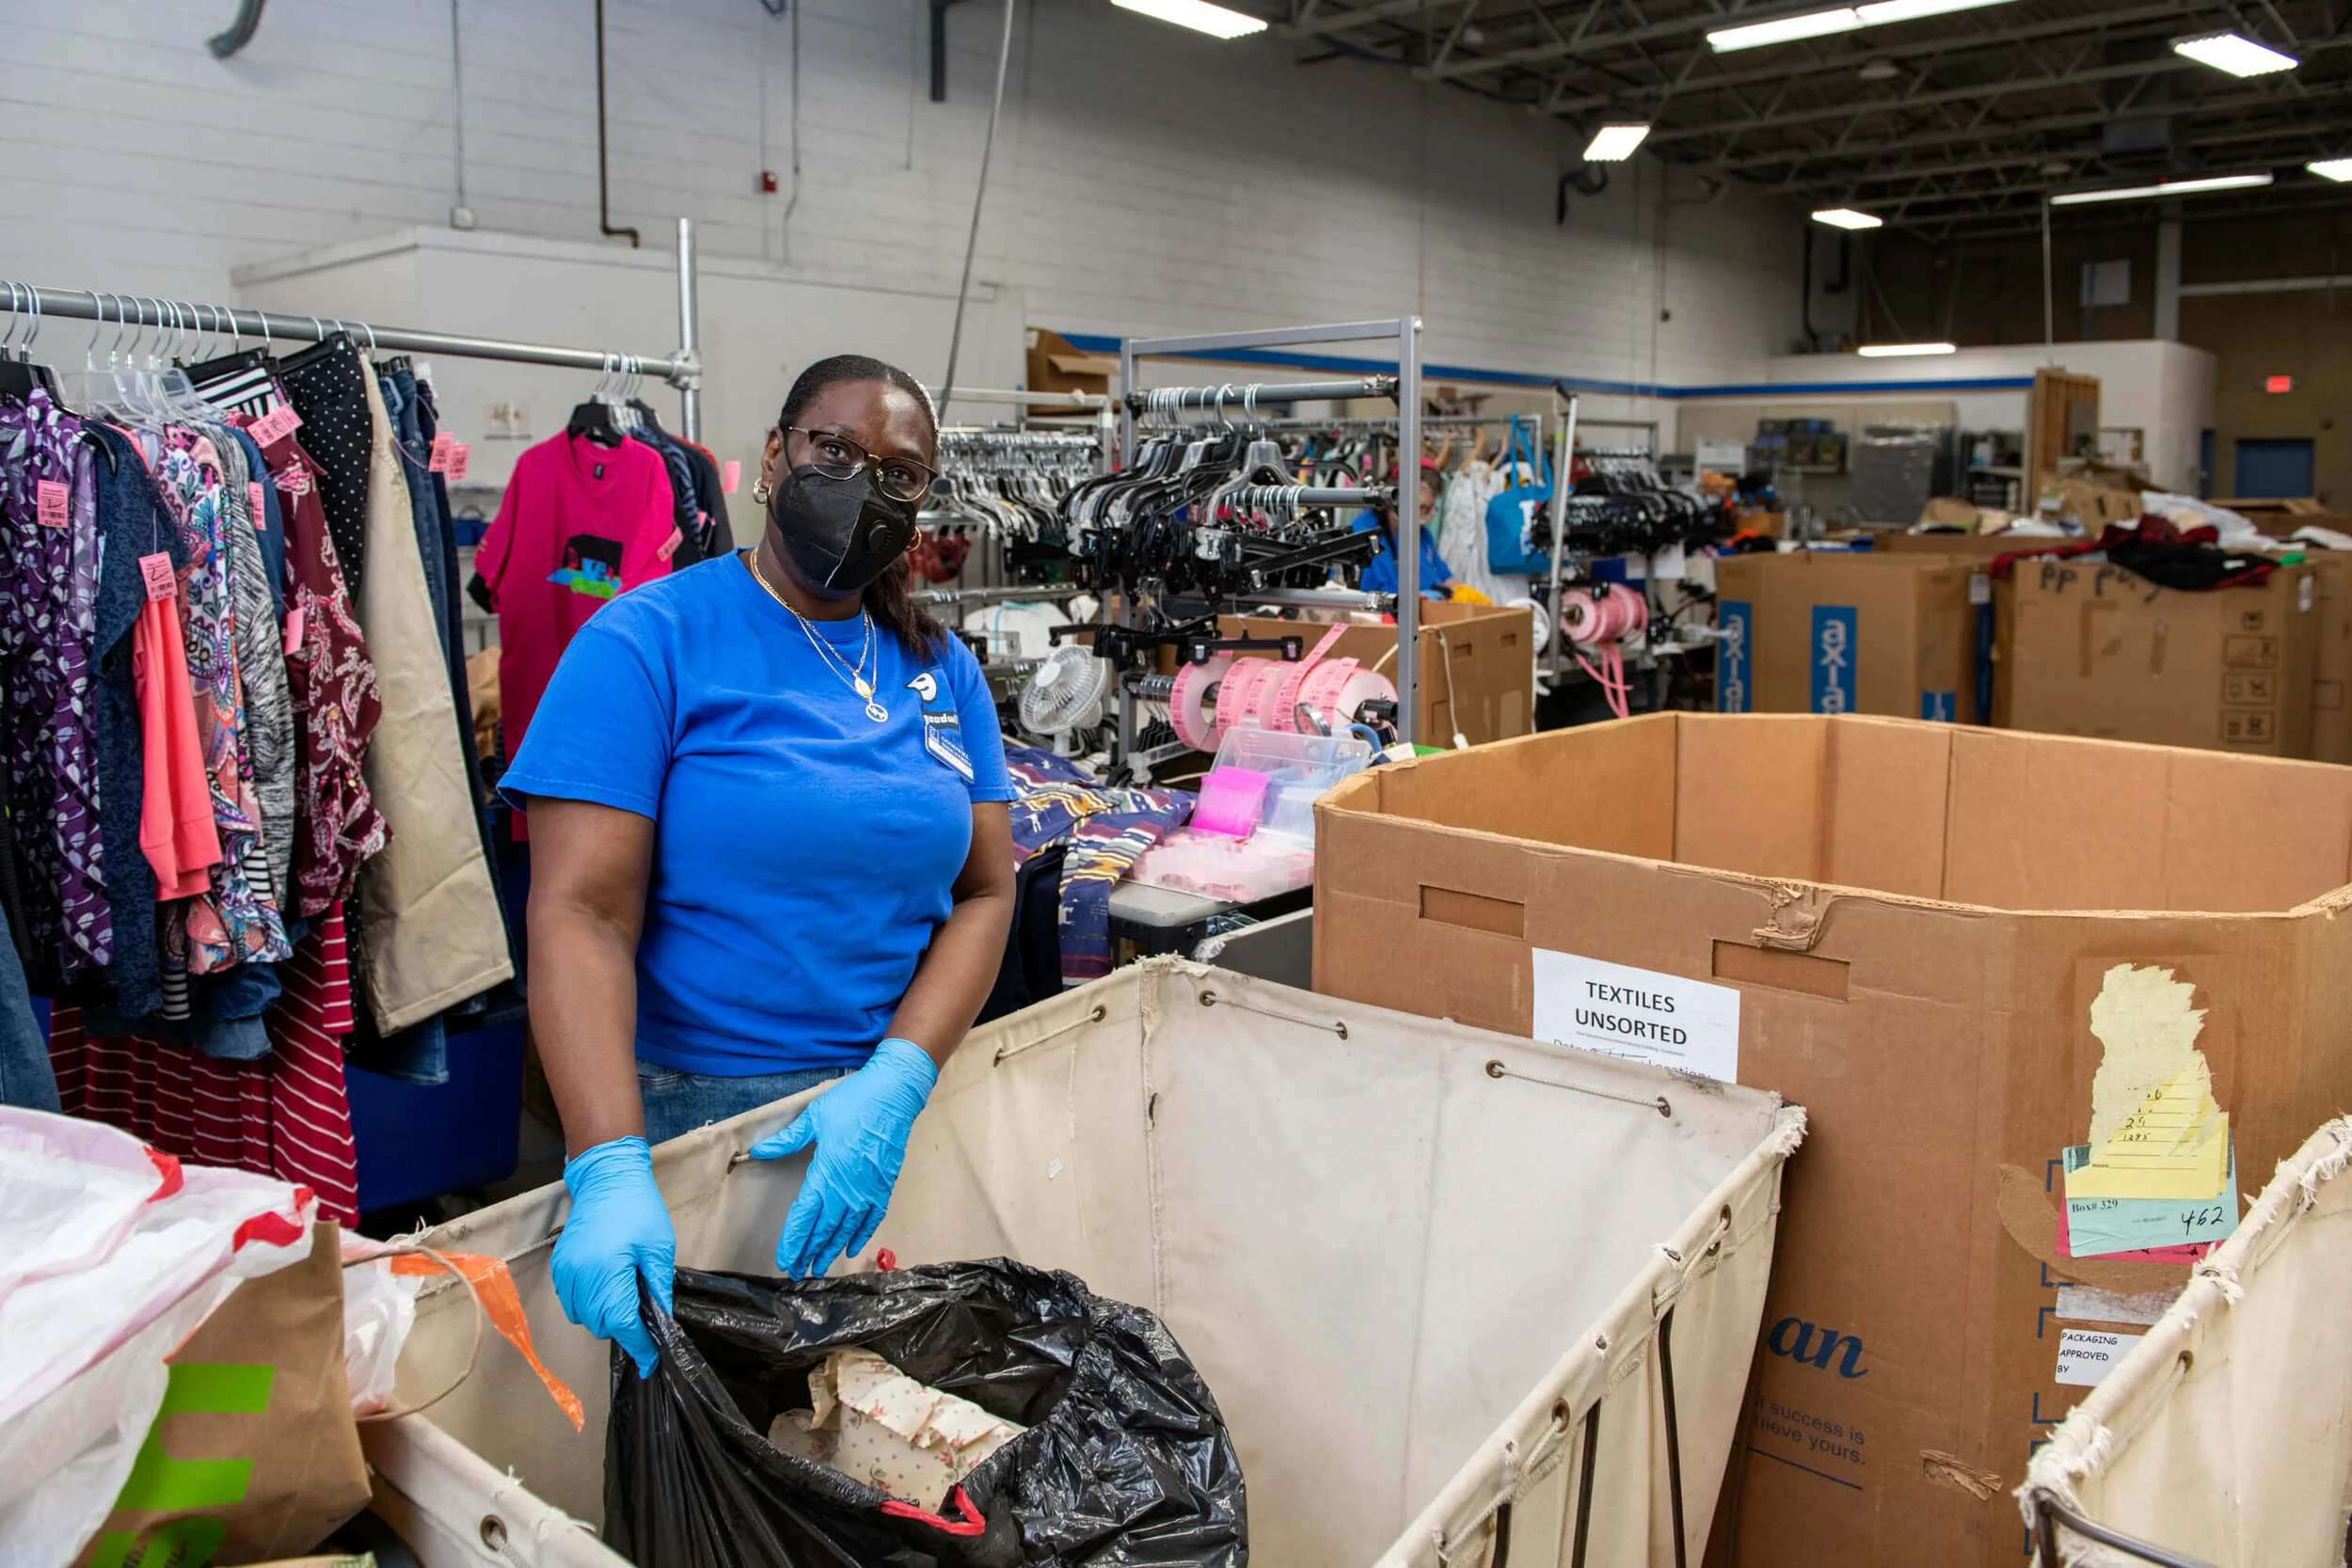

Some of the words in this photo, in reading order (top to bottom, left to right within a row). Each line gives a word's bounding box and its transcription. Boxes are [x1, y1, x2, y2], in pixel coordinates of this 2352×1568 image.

[1585, 981, 1675, 1013] TEXTILES
[1575, 1008, 1687, 1044] UNSORTED
[2072, 1201, 2098, 1213] Box#
[2100, 1199, 2119, 1211] 329
[2181, 1206, 2224, 1237] 462
[2061, 1332, 2118, 1345] PACKAGING
[2057, 1364, 2070, 1373] BY
[2059, 1349, 2109, 1361] APPROVED
[1771, 1402, 1844, 1438] success
[1849, 1425, 1865, 1446] is
[1808, 1434, 1867, 1466] yours.
